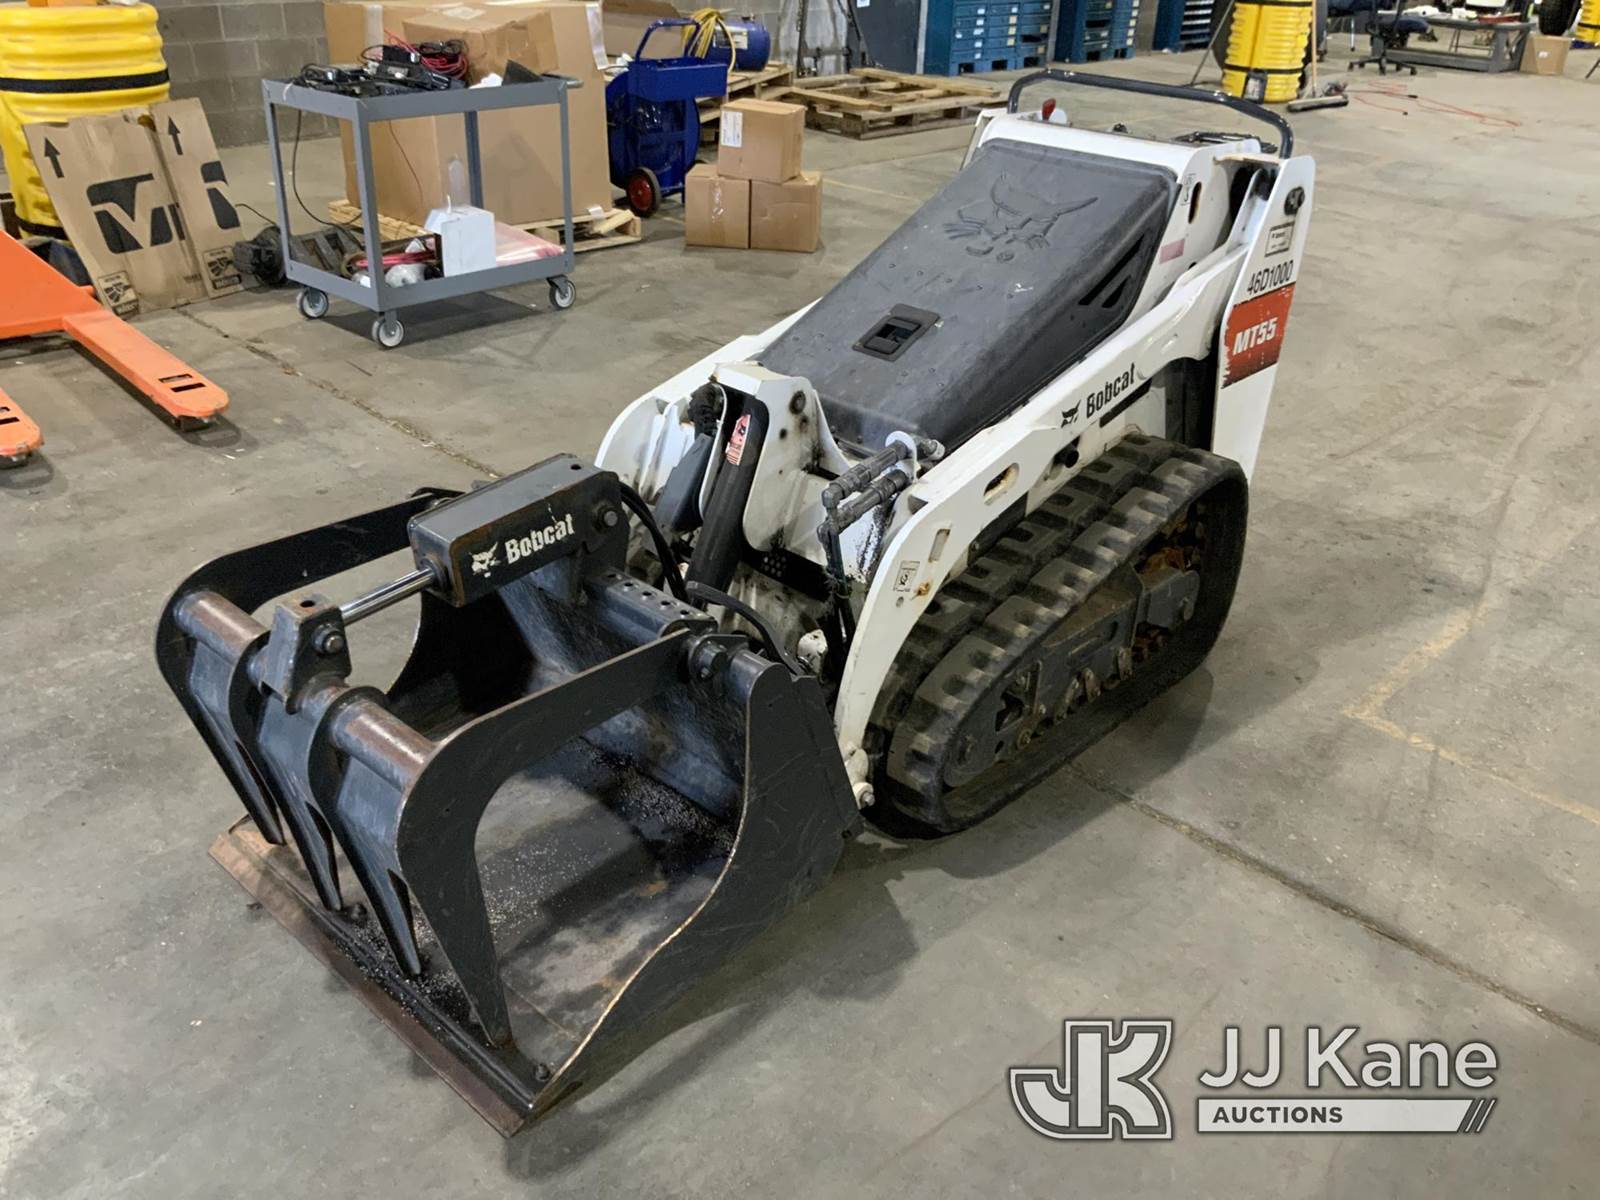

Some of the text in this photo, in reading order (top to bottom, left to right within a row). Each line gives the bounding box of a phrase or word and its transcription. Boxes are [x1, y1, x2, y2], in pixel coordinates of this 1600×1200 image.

[1247, 260, 1294, 295] 46D1000
[1232, 317, 1278, 356] MT55
[1086, 362, 1135, 419] Bobcat
[505, 513, 575, 565] Bobcat
